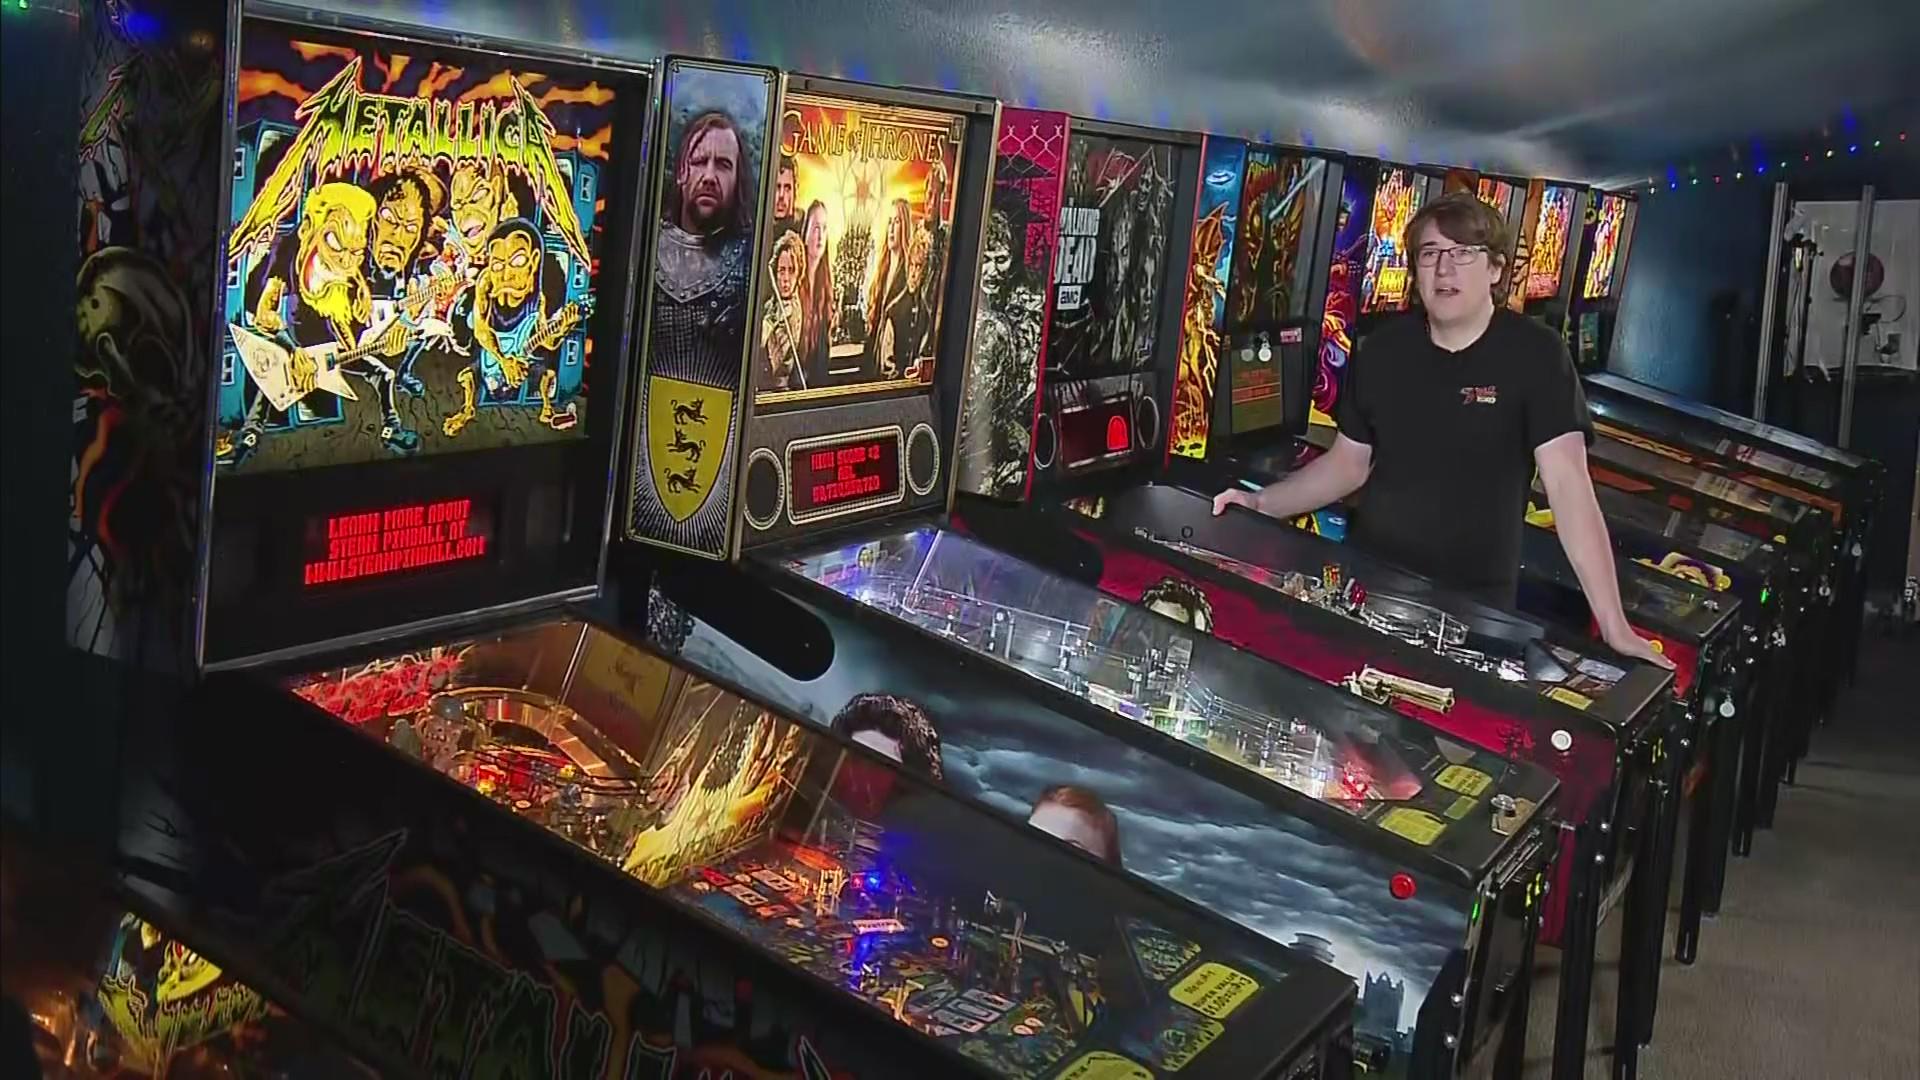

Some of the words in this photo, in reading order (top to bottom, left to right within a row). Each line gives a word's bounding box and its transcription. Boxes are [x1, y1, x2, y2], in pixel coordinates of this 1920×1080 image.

[780, 110, 847, 158] GAME
[860, 117, 949, 162] THRONES
[328, 512, 379, 539] LEARN
[383, 506, 424, 531] MORE
[428, 499, 471, 524] ABOUT
[383, 525, 444, 551] PINBALL
[448, 520, 467, 540] AT
